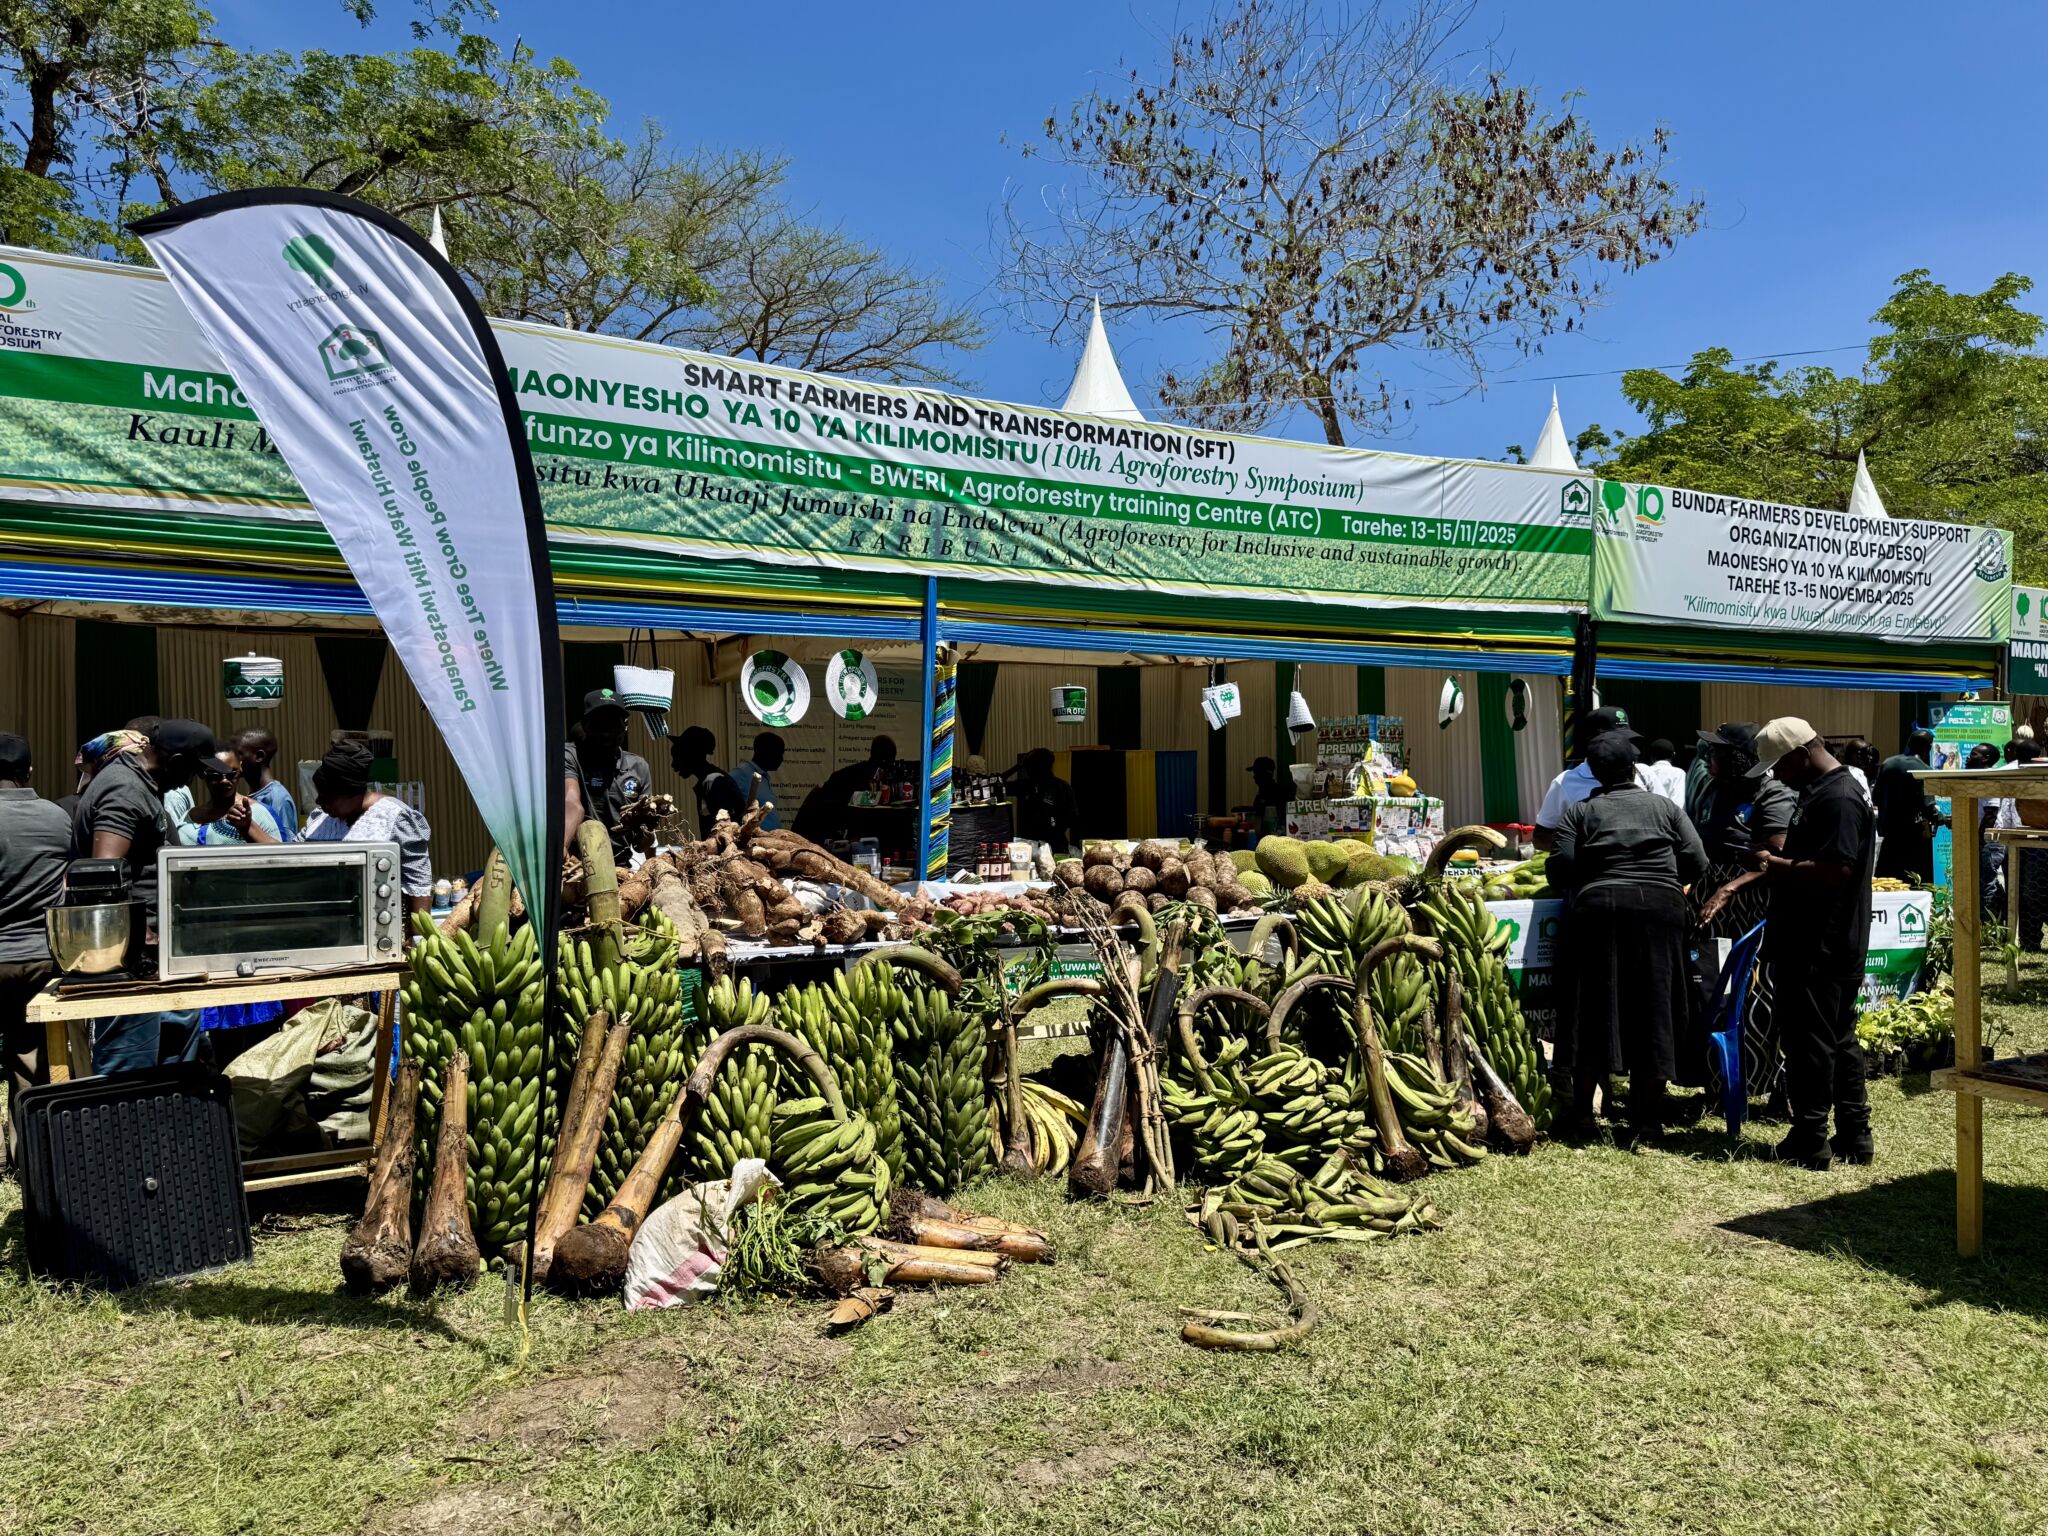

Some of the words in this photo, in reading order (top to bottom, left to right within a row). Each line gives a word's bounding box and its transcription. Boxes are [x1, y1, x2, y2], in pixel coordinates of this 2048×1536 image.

[126, 414, 235, 449] Kauli
[684, 364, 782, 400] SMART
[789, 381, 907, 420] FARMERS
[914, 402, 969, 427] AND
[974, 409, 1182, 455] TRANSFORMATION
[1186, 435, 1235, 464] (SFT)
[723, 399, 763, 428] YA
[770, 408, 801, 433] 10
[811, 413, 848, 440] YA
[855, 420, 1038, 464] KILIMOMISITU
[1041, 442, 1102, 473] (10th
[1108, 451, 1238, 495] Agroforestry
[1245, 466, 1364, 505] Symposium)
[620, 433, 658, 460] ya
[666, 435, 842, 480] Kilimomisitu
[870, 464, 954, 497] BWERI,
[960, 477, 1103, 516] Agroforestry
[1109, 492, 1191, 525] training
[1196, 502, 1262, 525] Centre
[1268, 507, 1322, 535] (ATC)
[1341, 515, 1407, 539] Tarehe:
[1410, 520, 1517, 545] 13-15/11/2025
[602, 465, 660, 494] kwa
[673, 473, 770, 515] Ukuaji
[777, 488, 894, 521] Jumuishi
[902, 507, 932, 525] na
[1059, 518, 1196, 556] (Agroforestry
[1195, 531, 1228, 558] for
[1234, 535, 1315, 560] Inclusive
[1320, 544, 1354, 562] and
[1359, 549, 1454, 569] sustainable
[1457, 554, 1523, 576] growth).
[1672, 490, 1726, 516] BUNDA
[1730, 500, 1801, 526] FARMERS
[1804, 511, 1909, 538] DEVELOPMENT
[1911, 523, 1971, 543] SUPPORT
[1729, 525, 1842, 555] ORGANIZATION
[1845, 540, 1927, 564] (BUFADESO)
[1707, 550, 1788, 574] MAONESHO
[1791, 559, 1808, 576] YA
[1811, 562, 1825, 578] 10
[1828, 564, 1844, 580] YA
[1847, 566, 1932, 587] KILIMOMISITU
[1727, 575, 1781, 595] TAREHE
[1783, 581, 1817, 599] 13-15
[1819, 585, 1883, 604] NOVEMBA
[1885, 591, 1914, 606] 2025
[1763, 603, 1787, 620] kwa
[1790, 605, 1826, 626] Ukuaji
[1879, 616, 1892, 627] na
[1326, 743, 1364, 754] PREMIX
